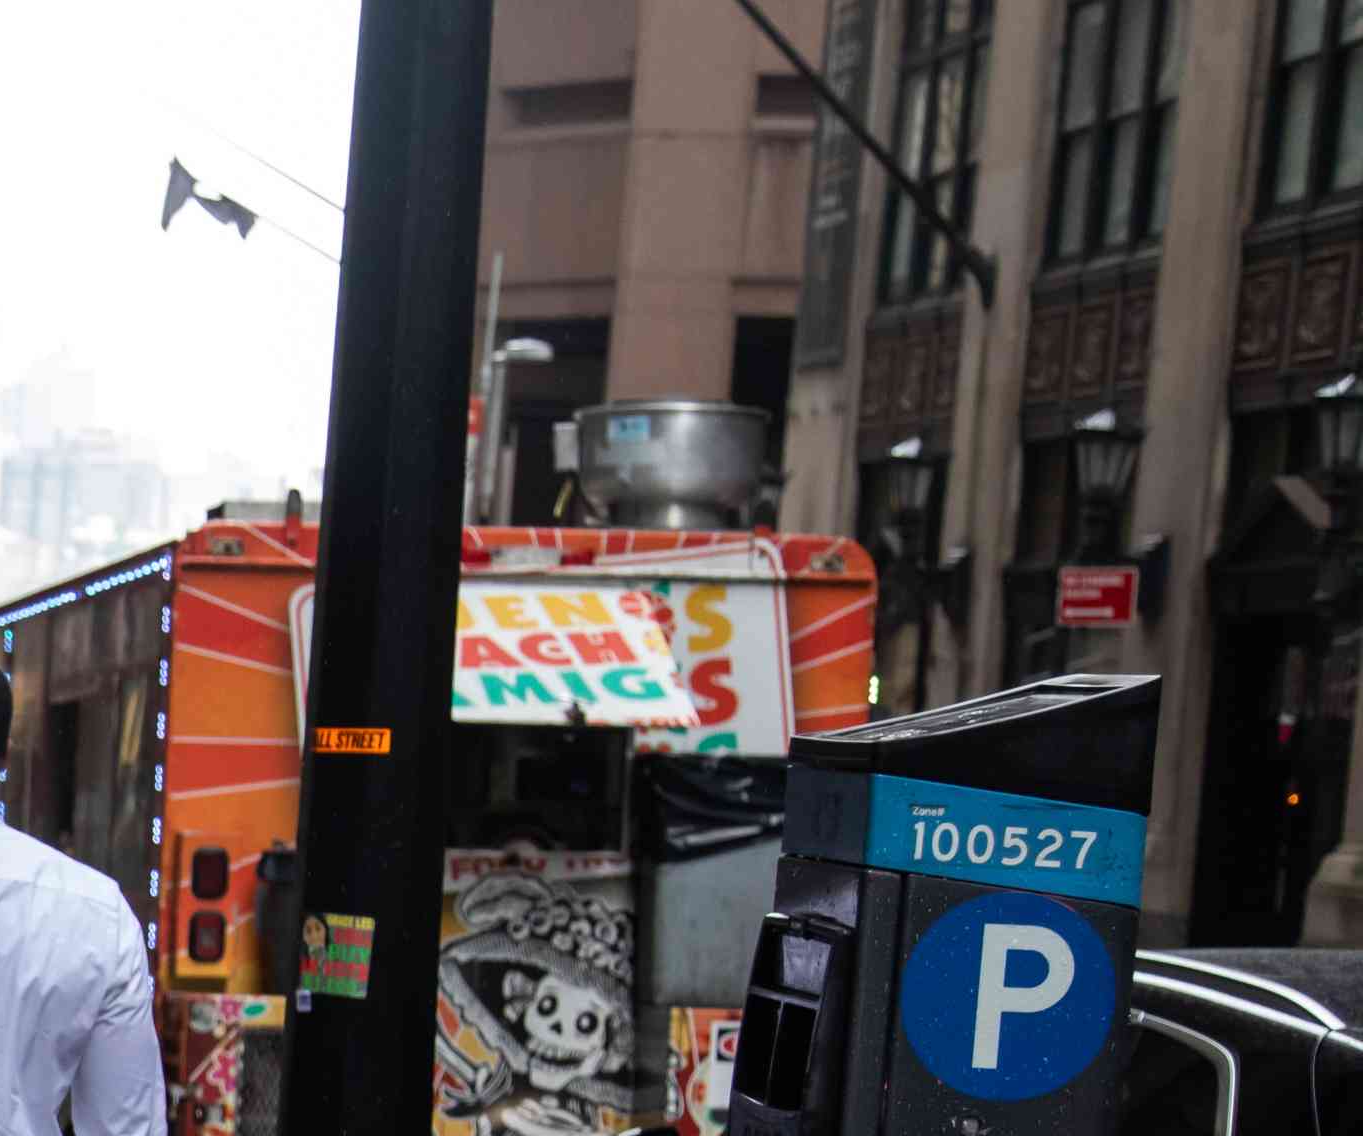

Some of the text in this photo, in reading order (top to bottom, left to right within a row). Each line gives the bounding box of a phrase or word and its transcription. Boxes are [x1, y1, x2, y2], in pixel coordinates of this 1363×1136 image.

[337, 730, 386, 748] STREET
[912, 805, 944, 817] Zone#
[913, 821, 1098, 869] 100527
[972, 923, 1075, 1069] P
